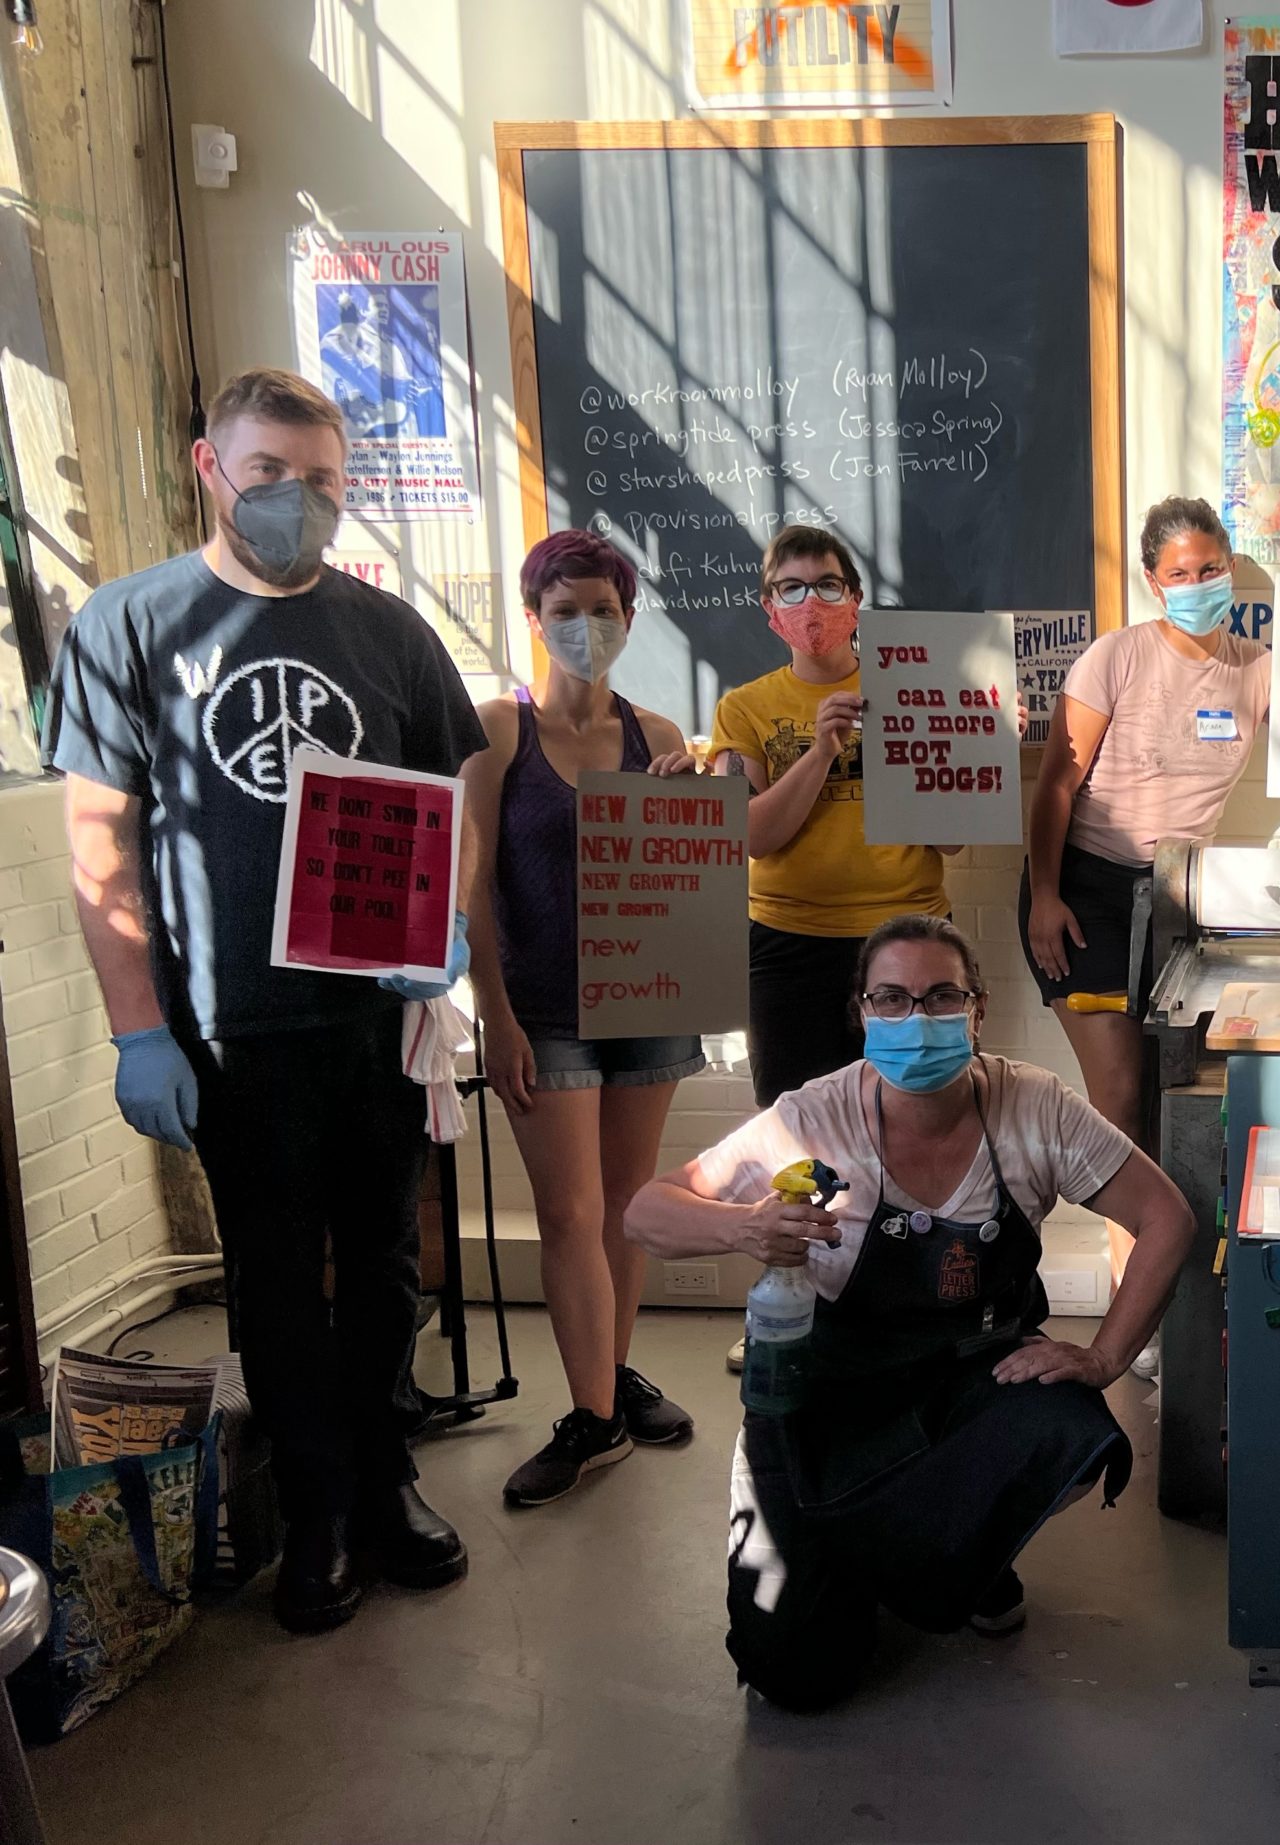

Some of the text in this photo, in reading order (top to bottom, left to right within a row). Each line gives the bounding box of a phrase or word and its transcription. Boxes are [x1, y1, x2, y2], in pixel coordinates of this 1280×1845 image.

[734, 4, 899, 66] FUTILITY
[311, 255, 440, 282] JOHNNY CASH
[580, 348, 987, 417] @workroommolloy (Ryan Molloy)
[839, 406, 926, 440] (Jessica
[933, 402, 1003, 447] Spring)
[380, 451, 410, 462] Waylon
[898, 442, 987, 483] Farrell)
[365, 479, 464, 487] CITY MUSIC HALL
[407, 465, 462, 475] Willie Nelson
[400, 492, 468, 502] TICKETS $15.00
[444, 581, 491, 623] HOPE
[877, 646, 929, 669] you
[897, 684, 1001, 709] can eat
[882, 715, 915, 734] no
[928, 715, 996, 735] more
[884, 740, 952, 766] HOT
[915, 766, 1002, 793] DOGS!
[311, 791, 330, 812] WE
[383, 804, 417, 826] SWIM
[426, 811, 440, 829] IN
[582, 794, 724, 826] NEW GROWTH
[328, 827, 415, 857] YOUR TOILET
[581, 835, 743, 866] NEW GROWTH
[306, 857, 430, 892] SO PEE IN
[581, 873, 700, 892] NEW GROWTH
[330, 894, 397, 919] OUR POOL
[581, 903, 669, 917] NEW GROWTH
[581, 938, 641, 957] new
[582, 972, 681, 1009] growth
[942, 1284, 976, 1296] PRESS
[943, 1272, 975, 1285] LETTER
